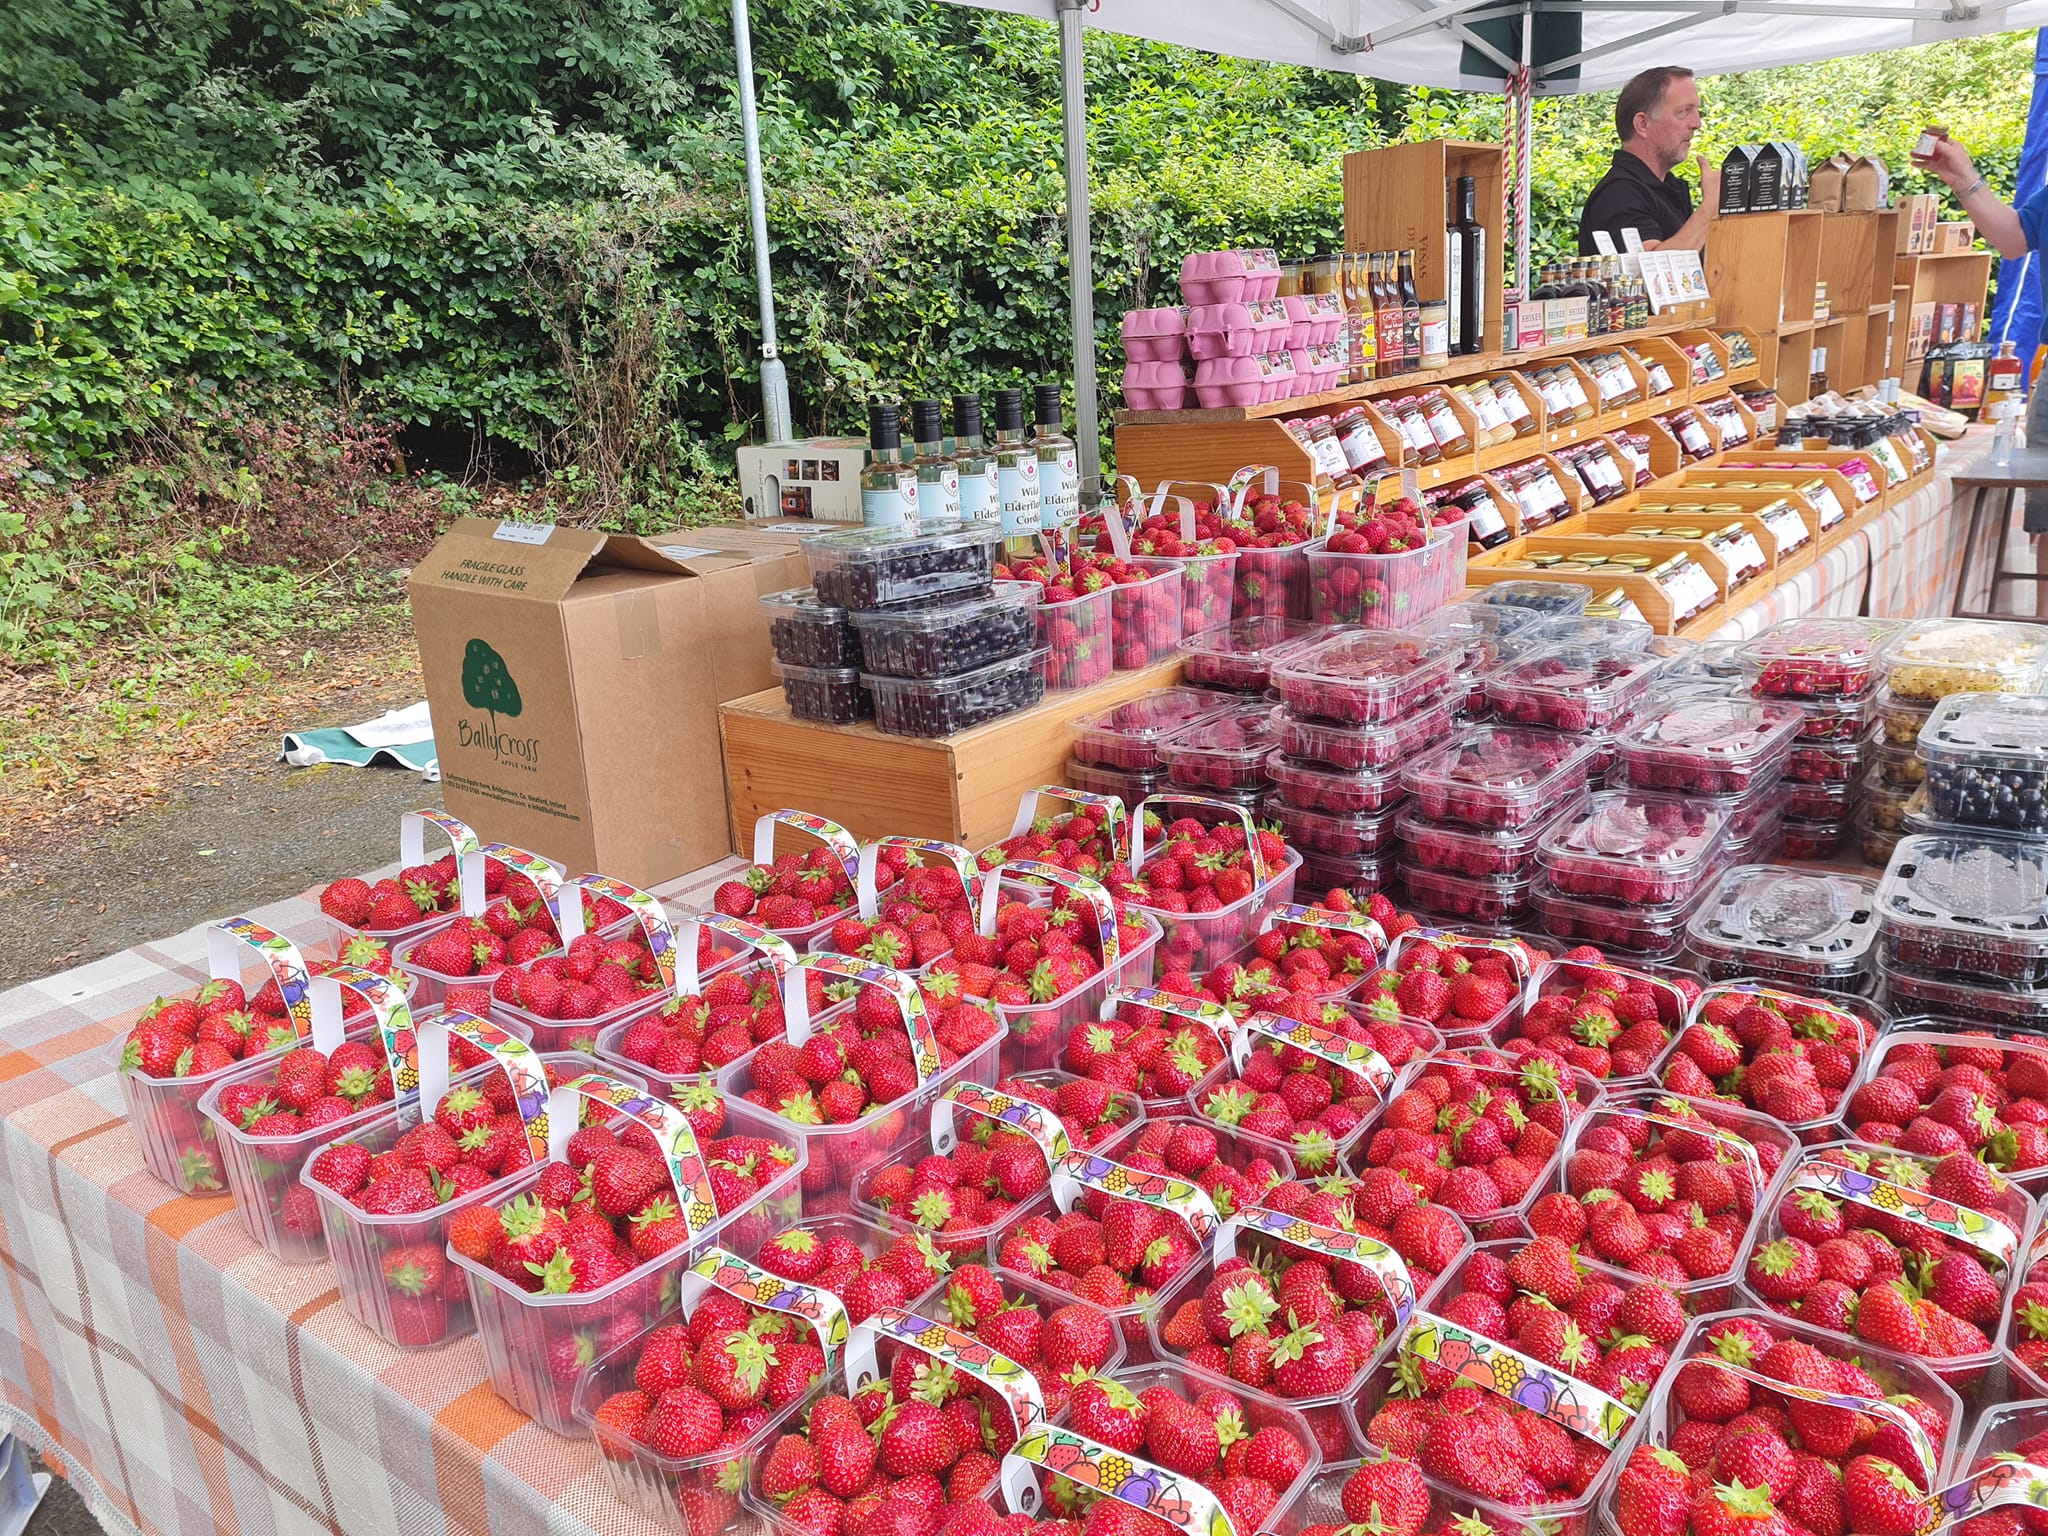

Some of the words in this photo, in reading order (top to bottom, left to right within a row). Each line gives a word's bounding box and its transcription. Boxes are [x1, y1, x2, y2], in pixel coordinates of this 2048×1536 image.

[459, 559, 497, 573] FRAGILE
[496, 564, 526, 577] GLASS
[440, 570, 478, 585] HANDLE
[478, 575, 502, 588] WITH
[502, 580, 528, 592] CARE
[501, 760, 519, 769] APPLE
[520, 762, 537, 773] FARM
[549, 800, 567, 810] Ireland
